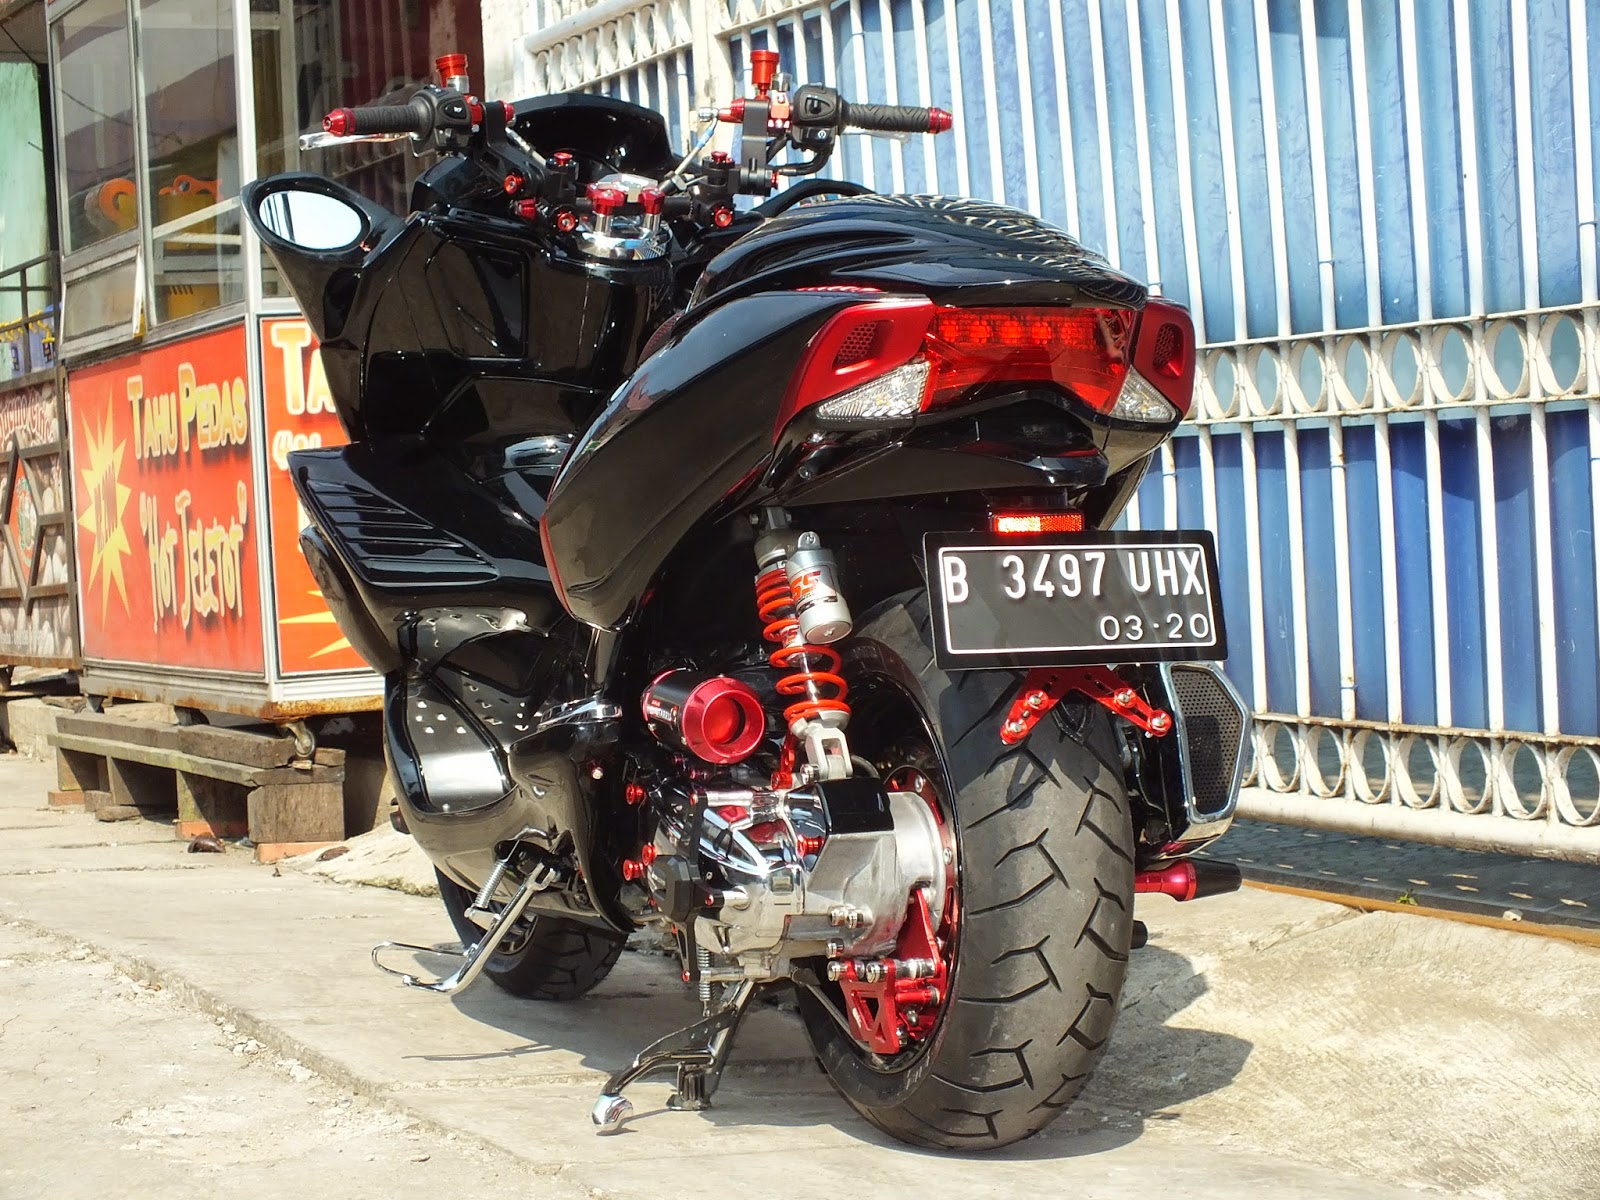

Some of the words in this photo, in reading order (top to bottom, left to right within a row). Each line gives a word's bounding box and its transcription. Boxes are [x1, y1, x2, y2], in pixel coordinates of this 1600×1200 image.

[943, 556, 969, 603] B
[1002, 552, 1106, 599] 3497
[1127, 550, 1205, 597] UHX
